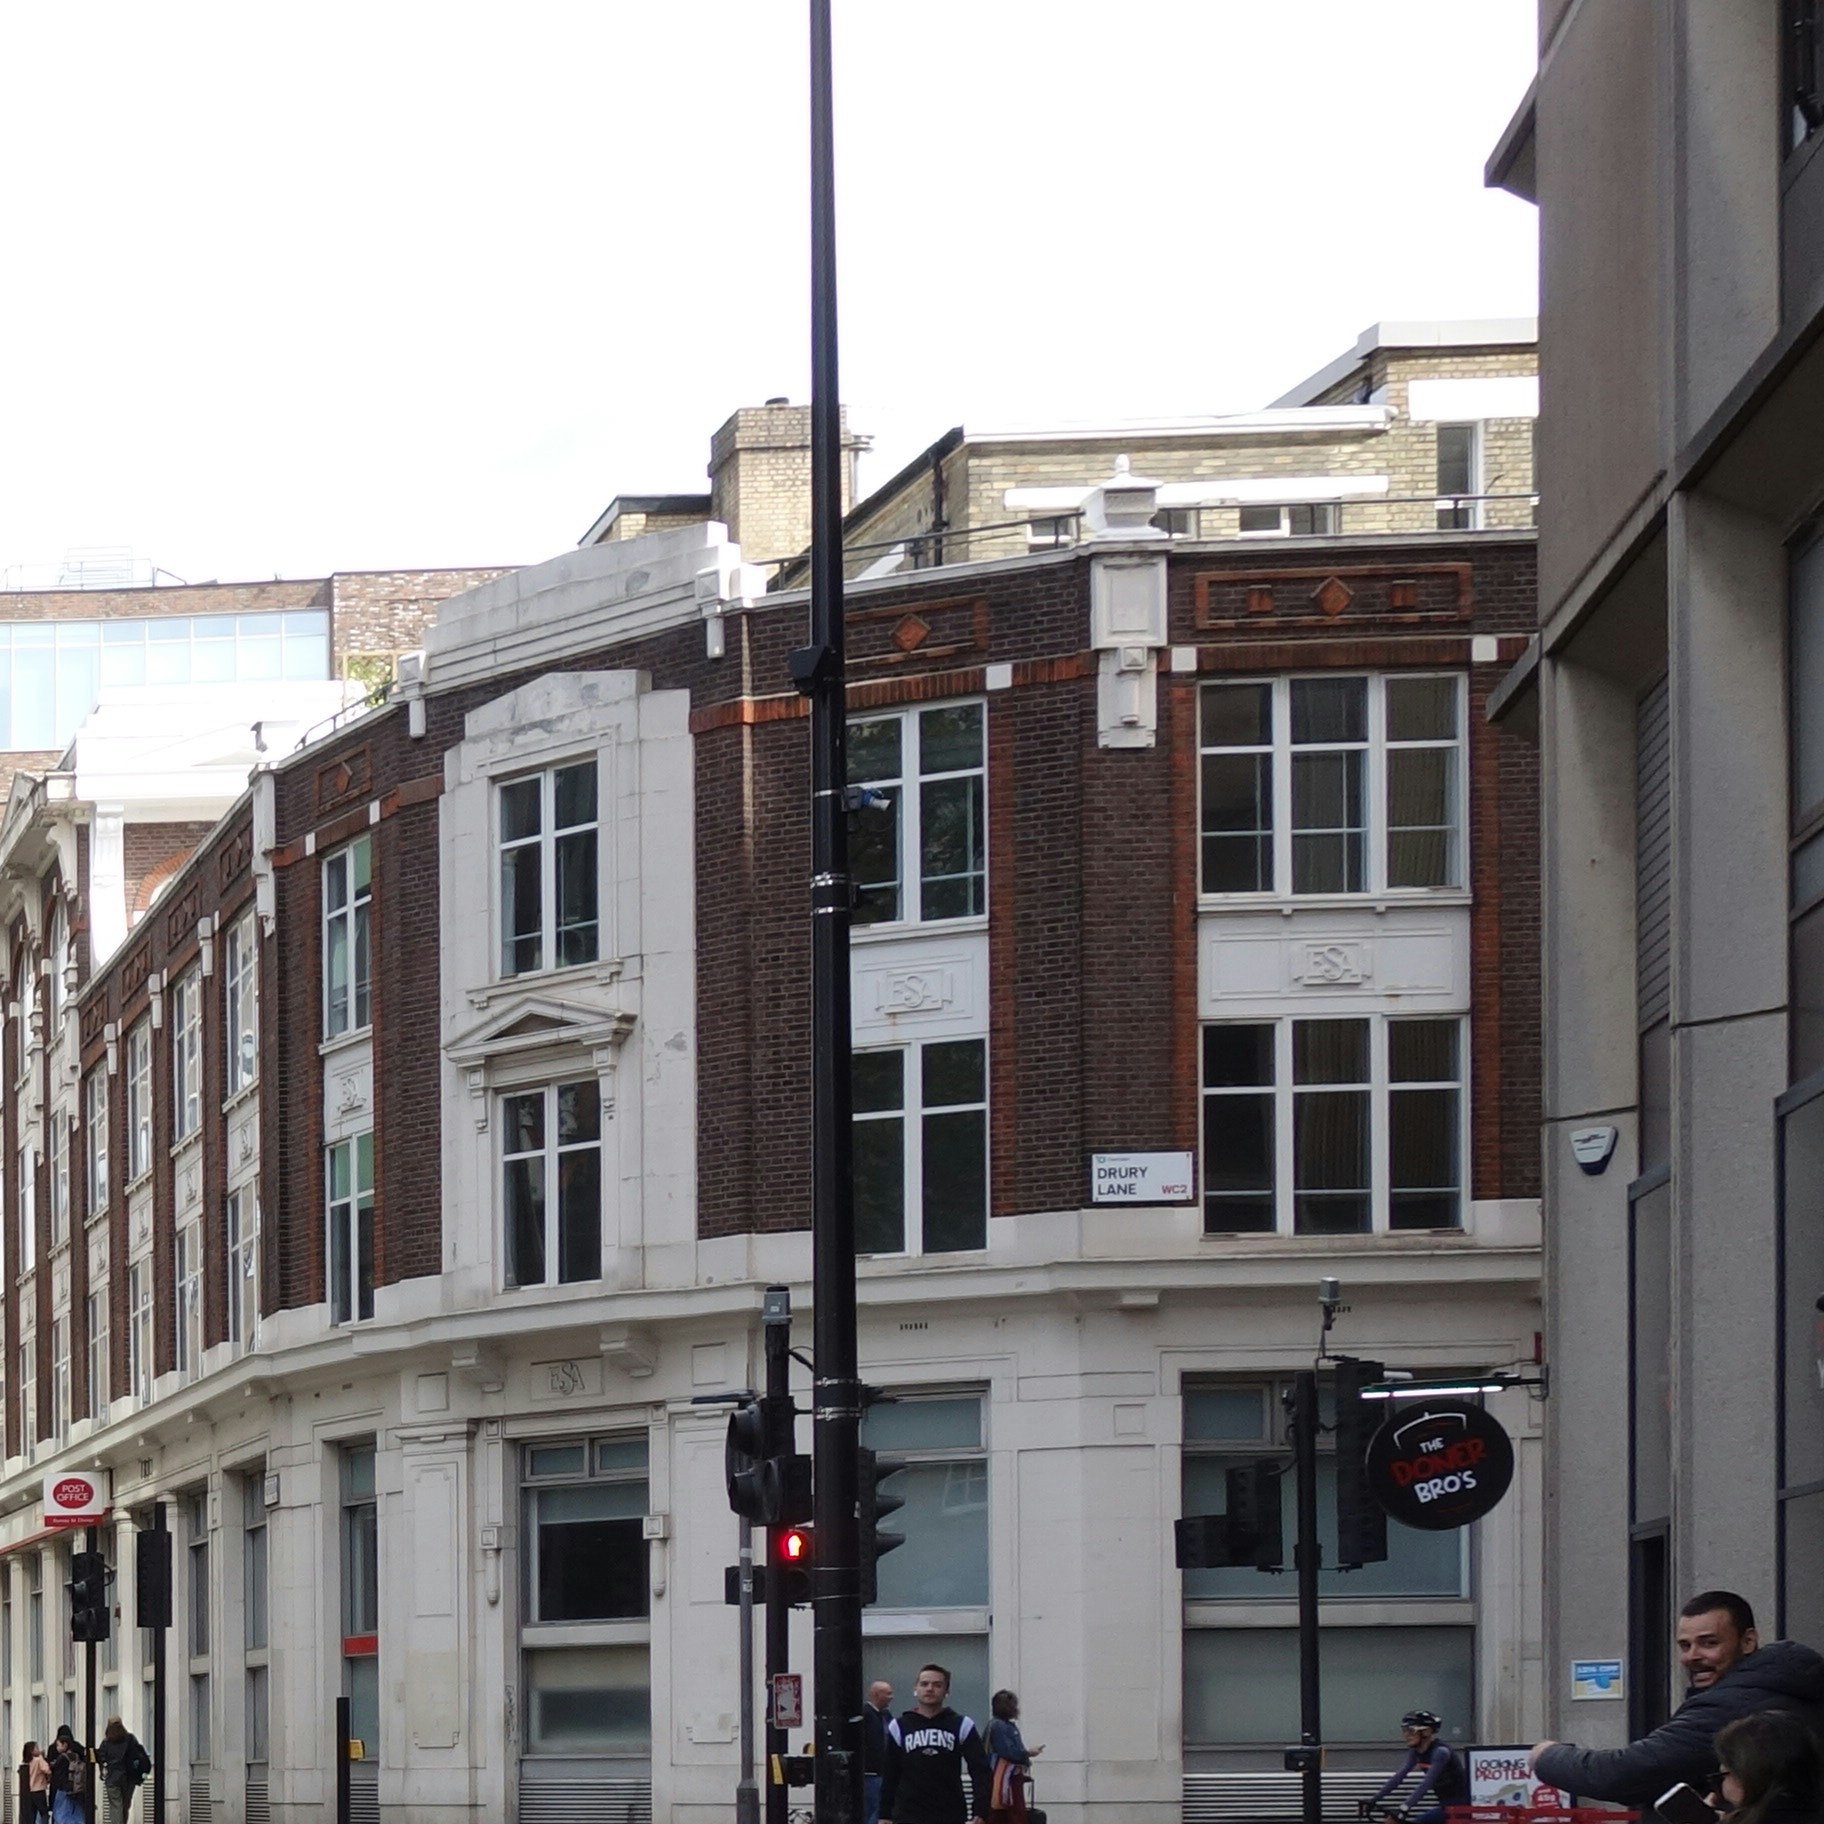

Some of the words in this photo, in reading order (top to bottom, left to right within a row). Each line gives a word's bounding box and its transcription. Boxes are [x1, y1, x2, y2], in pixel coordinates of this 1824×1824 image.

[1097, 1167, 1148, 1180] DRURY
[1097, 1184, 1136, 1196] LANE
[1162, 1185, 1188, 1195] WC2
[1419, 1437, 1445, 1454] THE
[61, 1484, 85, 1493] POST
[1414, 1470, 1477, 1503] BRO'S
[56, 1492, 89, 1502] OFFICE
[904, 1728, 956, 1754] RAVENS
[1474, 1768, 1533, 1782] PROTEIN
